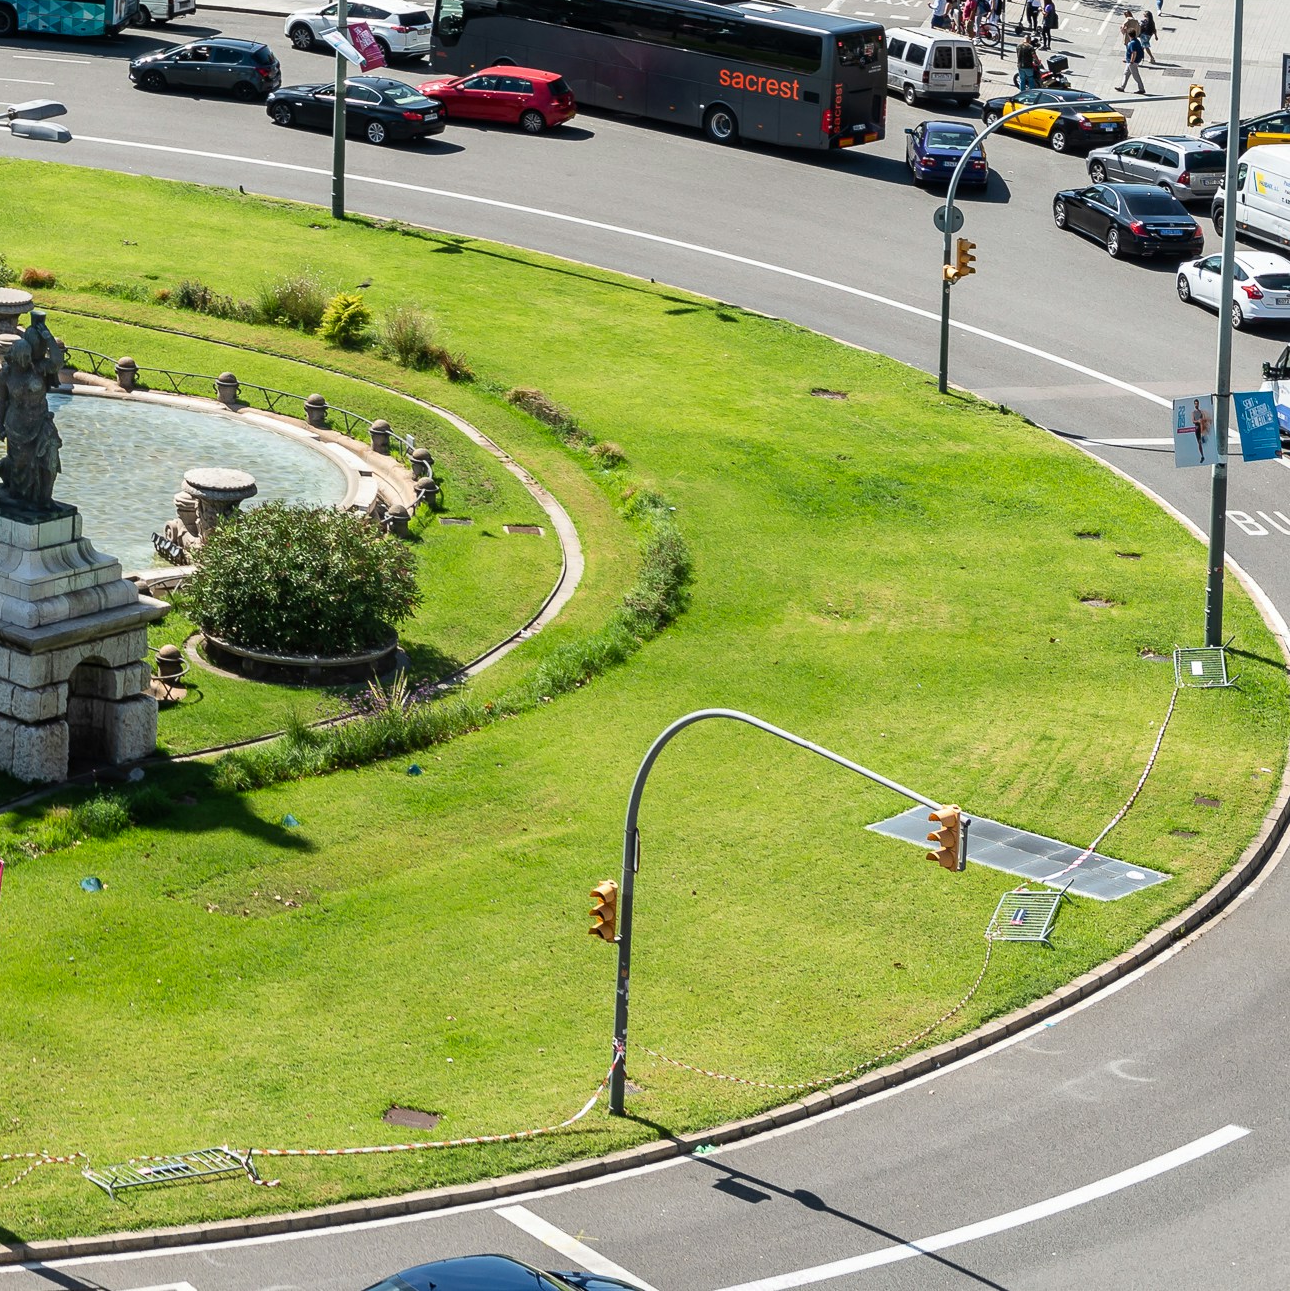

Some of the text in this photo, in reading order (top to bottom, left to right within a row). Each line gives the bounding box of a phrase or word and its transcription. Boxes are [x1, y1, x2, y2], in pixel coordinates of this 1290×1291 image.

[719, 68, 800, 101] sacrest
[833, 82, 843, 134] sacrest
[1225, 509, 1290, 536] BU
